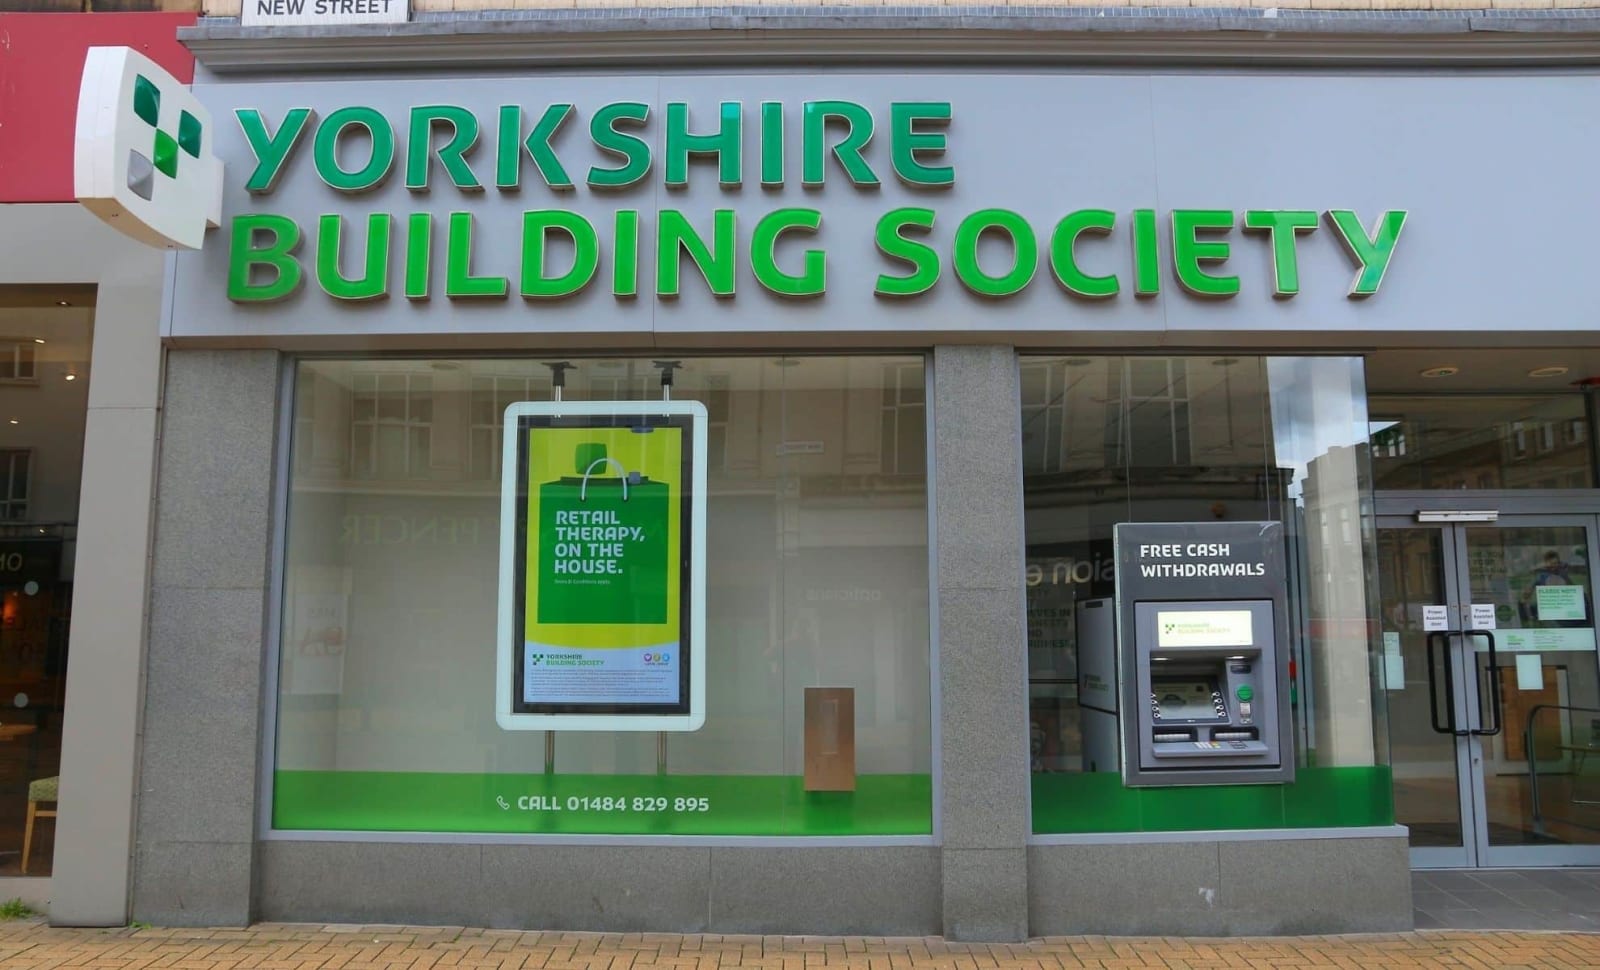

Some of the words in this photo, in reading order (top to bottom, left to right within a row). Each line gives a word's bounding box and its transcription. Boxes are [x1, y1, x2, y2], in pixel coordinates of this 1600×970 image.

[257, 0, 305, 15] NEW
[314, 0, 392, 14] STREET
[234, 100, 955, 193] YORKSHIRE
[226, 208, 827, 302] BUILDING
[873, 208, 1408, 300] SOCIETY
[555, 510, 621, 525] RETAIL
[555, 526, 645, 542] THERAPY,
[554, 543, 581, 558] ON
[587, 543, 624, 558] THE
[1140, 544, 1182, 558] FREE
[1186, 543, 1230, 557] CASH
[554, 559, 623, 574] HOUSE.
[1140, 562, 1265, 578] WITHDRAWALS
[517, 796, 561, 811] CALL
[567, 796, 627, 811] 01484
[632, 797, 668, 811] 829
[674, 797, 710, 811] 895
